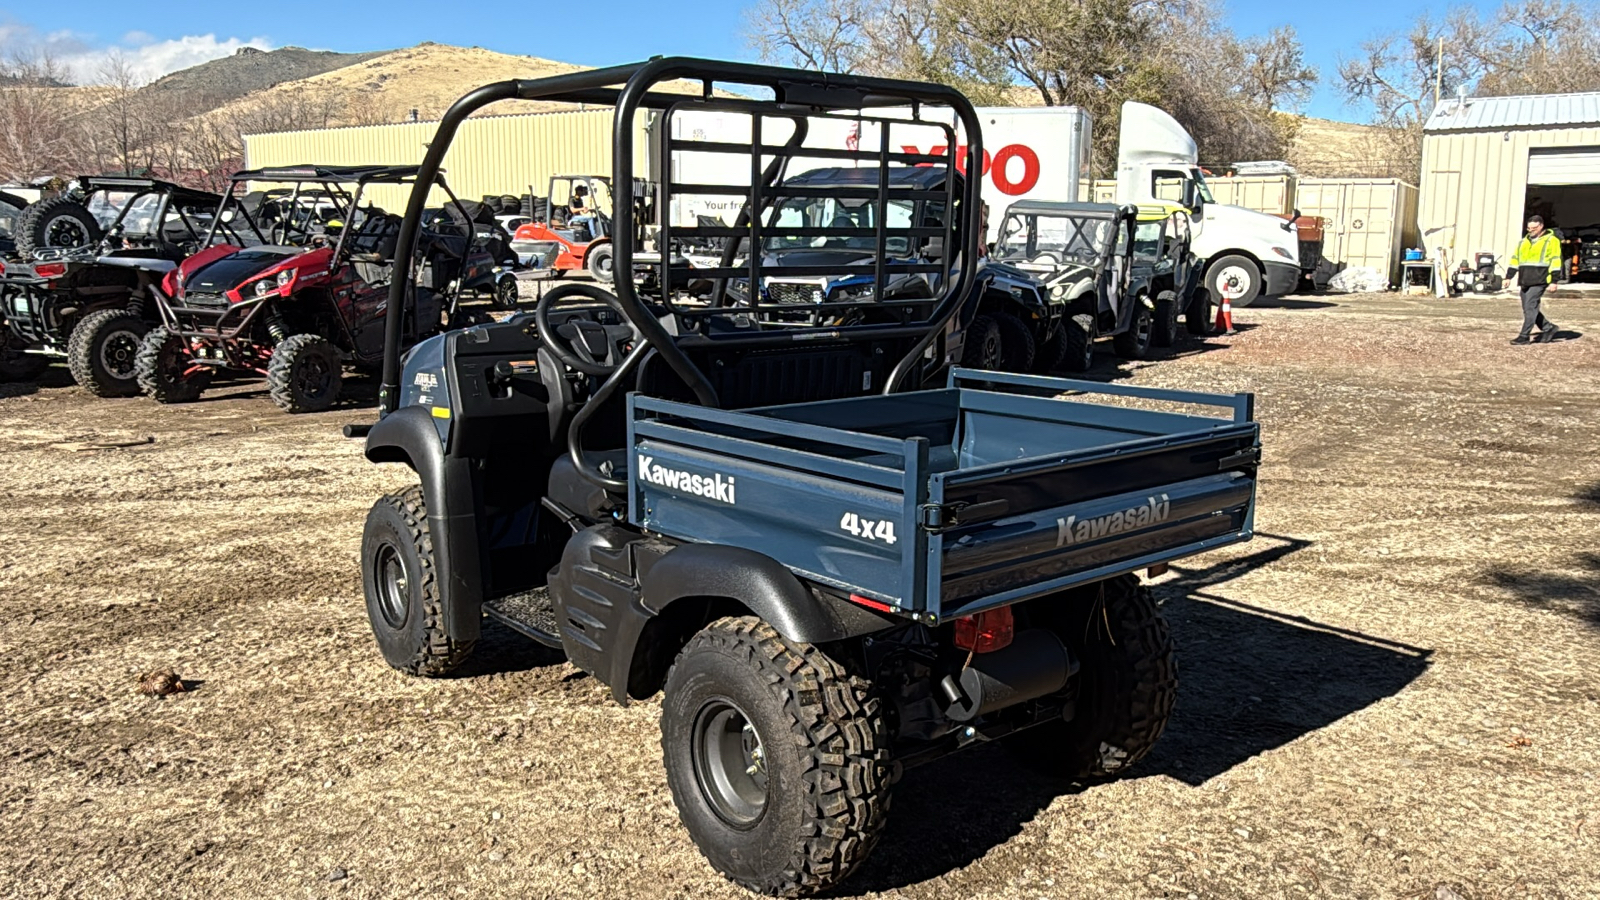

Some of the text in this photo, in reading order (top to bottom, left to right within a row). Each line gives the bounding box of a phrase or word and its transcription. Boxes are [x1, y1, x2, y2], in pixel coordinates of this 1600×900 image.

[901, 144, 1040, 196] PO
[704, 200, 727, 210] Your
[638, 454, 735, 505] Kawasaki
[840, 512, 897, 545] 4x4
[1056, 493, 1170, 547] Kawasaki
